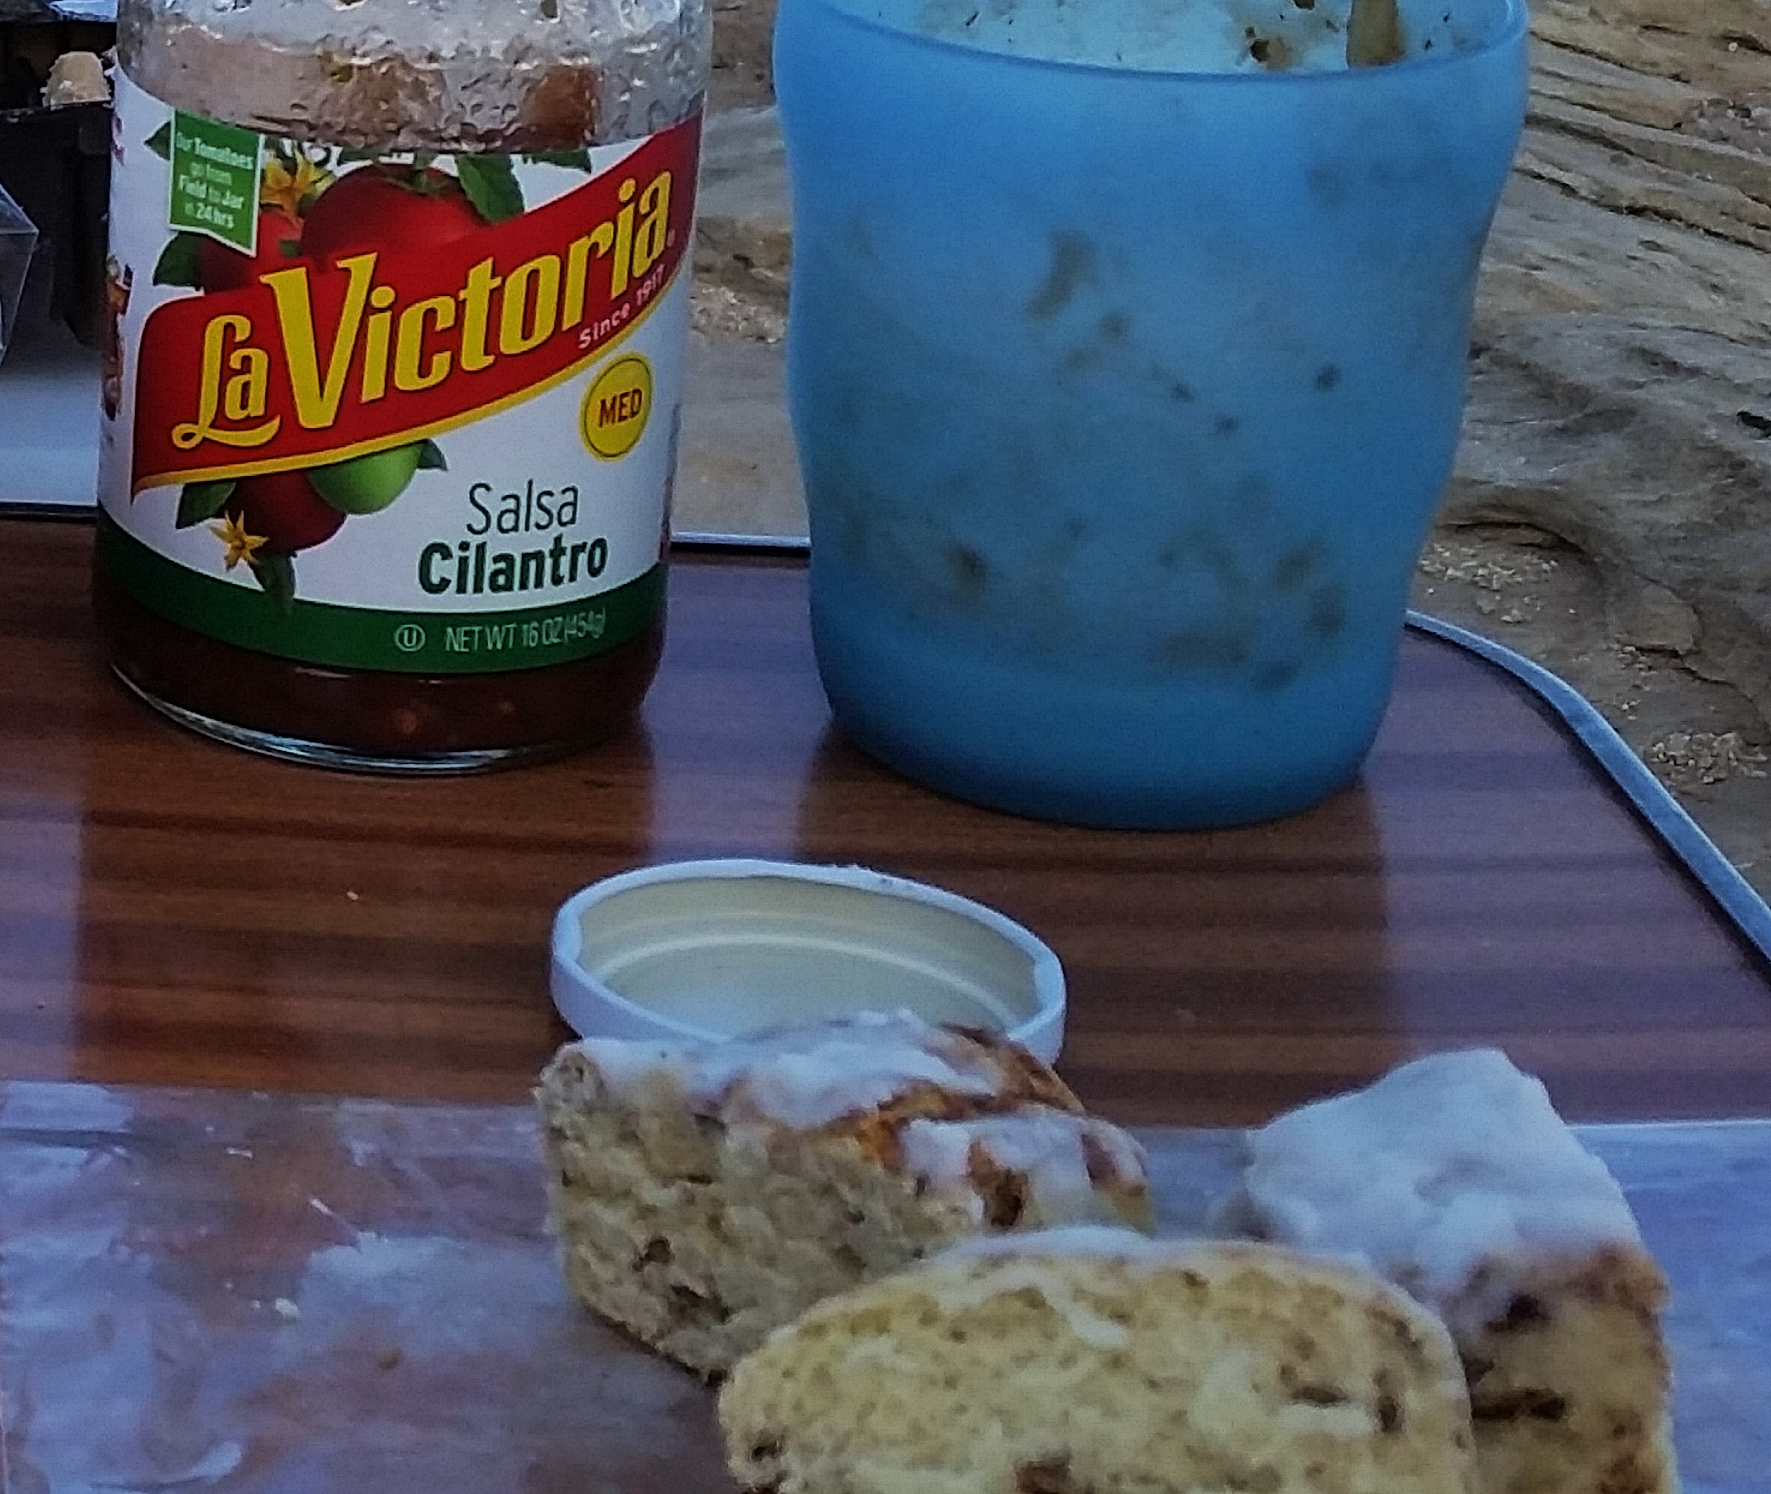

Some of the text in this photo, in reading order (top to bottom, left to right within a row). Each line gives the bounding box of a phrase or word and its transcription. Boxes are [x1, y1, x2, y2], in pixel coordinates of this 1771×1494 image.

[172, 170, 672, 449] La Victoria
[578, 302, 631, 349] Since
[598, 387, 643, 429] MED
[466, 478, 579, 536] Salsa
[417, 533, 609, 595] Cilantro
[444, 625, 483, 653] NET
[484, 622, 517, 651] WT
[521, 622, 539, 648] 16
